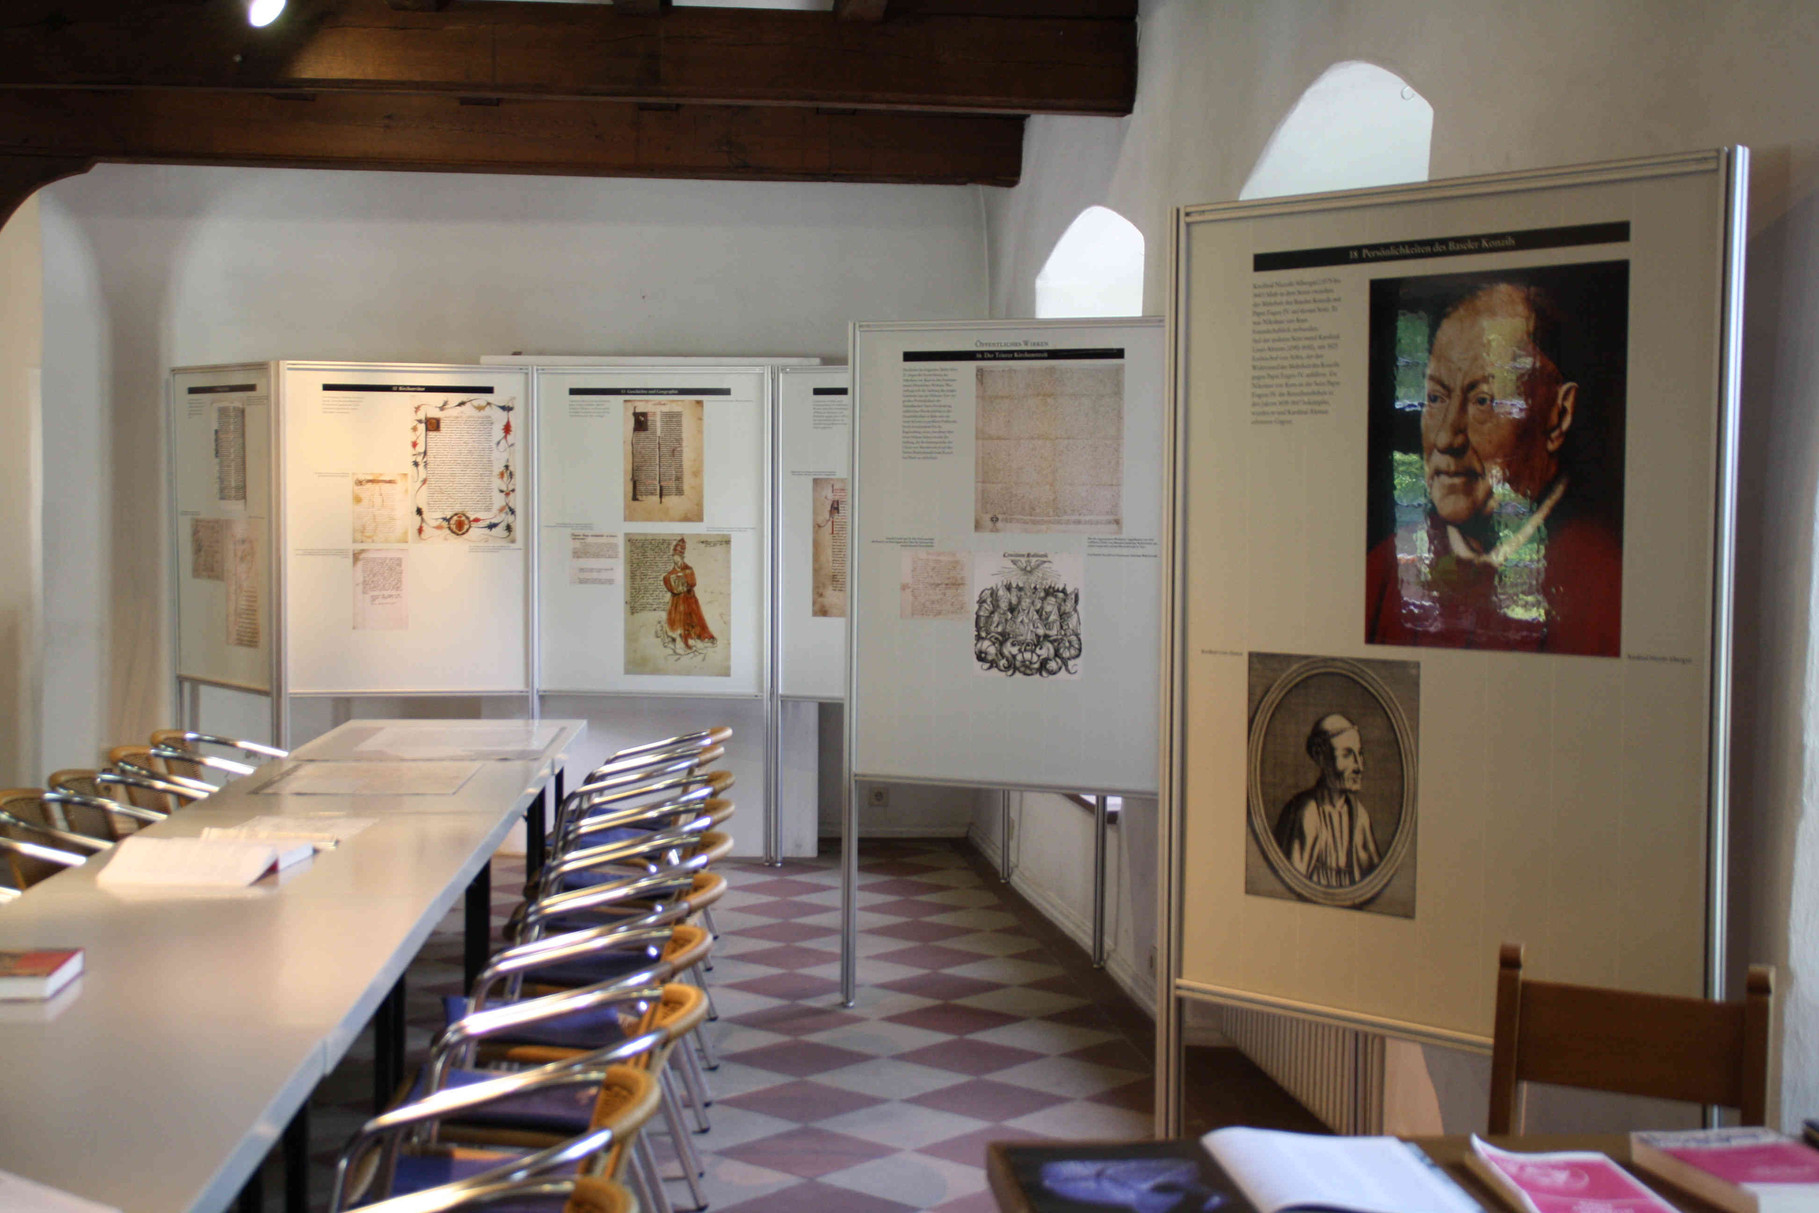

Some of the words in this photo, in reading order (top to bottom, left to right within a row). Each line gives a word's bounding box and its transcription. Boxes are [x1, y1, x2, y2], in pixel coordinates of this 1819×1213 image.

[1362, 243, 1432, 259] Persönlichkeiten
[1433, 243, 1447, 253] des
[1481, 236, 1516, 249] Konzils
